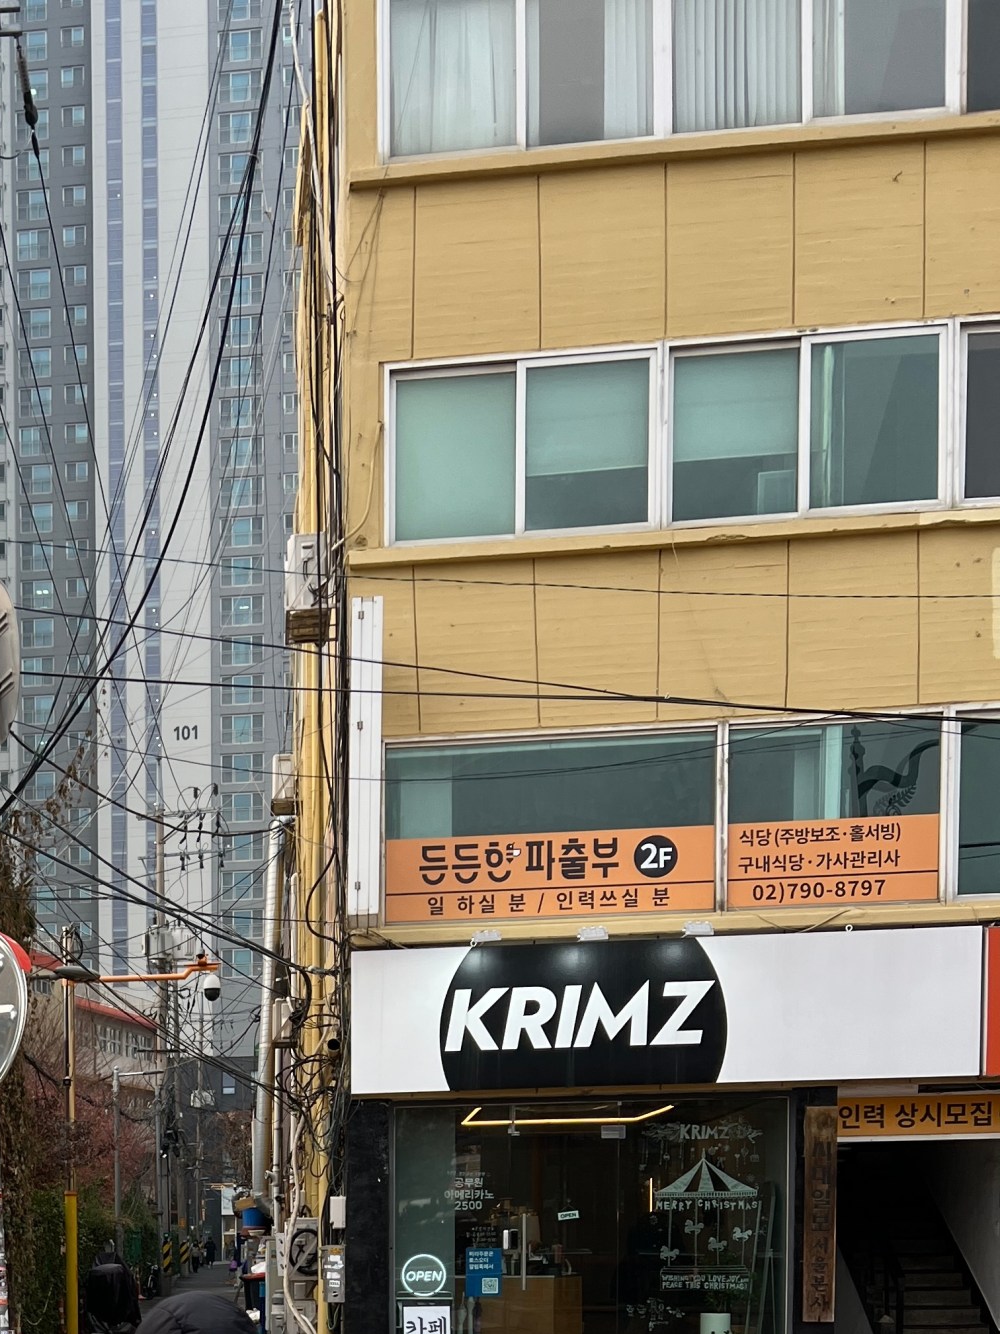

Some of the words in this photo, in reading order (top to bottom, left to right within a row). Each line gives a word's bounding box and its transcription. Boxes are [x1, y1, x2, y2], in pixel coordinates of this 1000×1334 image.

[173, 724, 198, 741] 101
[739, 828, 772, 847] 식당
[525, 837, 620, 881] 파출부
[639, 842, 673, 870] 2F
[752, 879, 886, 903] 02)790-8797
[427, 896, 445, 916] 일
[457, 893, 495, 914] 하실
[508, 893, 527, 912] 분
[556, 887, 639, 911] 인력쓰실
[652, 887, 670, 907] 분
[444, 979, 716, 1052] KRIMZ
[838, 1103, 885, 1130] 인력
[895, 1101, 992, 1128] 상시모집
[679, 1123, 730, 1140] KRIMZ
[454, 1177, 484, 1188] 공무원
[444, 1189, 495, 1200] 아메리카노
[454, 1200, 483, 1211] 2500
[656, 1200, 692, 1212] MERRY
[697, 1199, 759, 1212] CHRISTMAS
[559, 1212, 578, 1220] OPEN
[406, 1270, 442, 1282] OPEN
